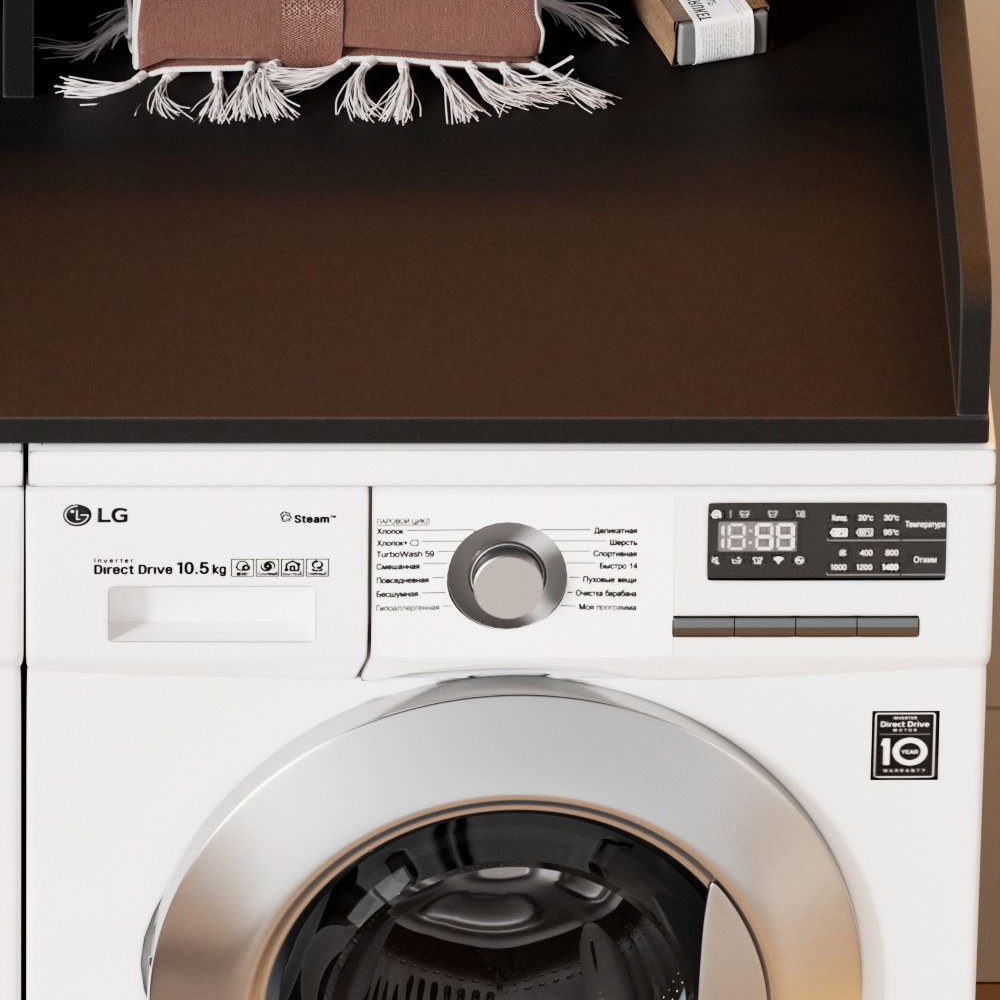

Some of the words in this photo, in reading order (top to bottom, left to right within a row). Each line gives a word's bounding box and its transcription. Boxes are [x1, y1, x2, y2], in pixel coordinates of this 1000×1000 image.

[97, 507, 129, 523] LG
[905, 520, 946, 530] Температура
[594, 527, 638, 535] Деликатная
[593, 550, 638, 558] Спортивная
[859, 549, 873, 557] 400
[884, 549, 899, 557] 800
[913, 556, 938, 564] Отжим
[93, 564, 134, 575] Direct
[138, 564, 173, 575] Drive
[177, 562, 210, 575] 10.5
[212, 564, 227, 577] kg
[376, 563, 420, 571] Смешанная
[599, 562, 628, 570] Быстро
[830, 563, 847, 571] 1000
[856, 563, 873, 571] 1200
[376, 577, 430, 585] Повседневная
[582, 576, 615, 585] Пуховые
[617, 577, 637, 585] вещи
[376, 591, 419, 599] Бесшумная
[575, 589, 603, 597] Очистка
[605, 590, 637, 598] барабана
[596, 604, 637, 612] программа
[880, 737, 929, 766] 10
